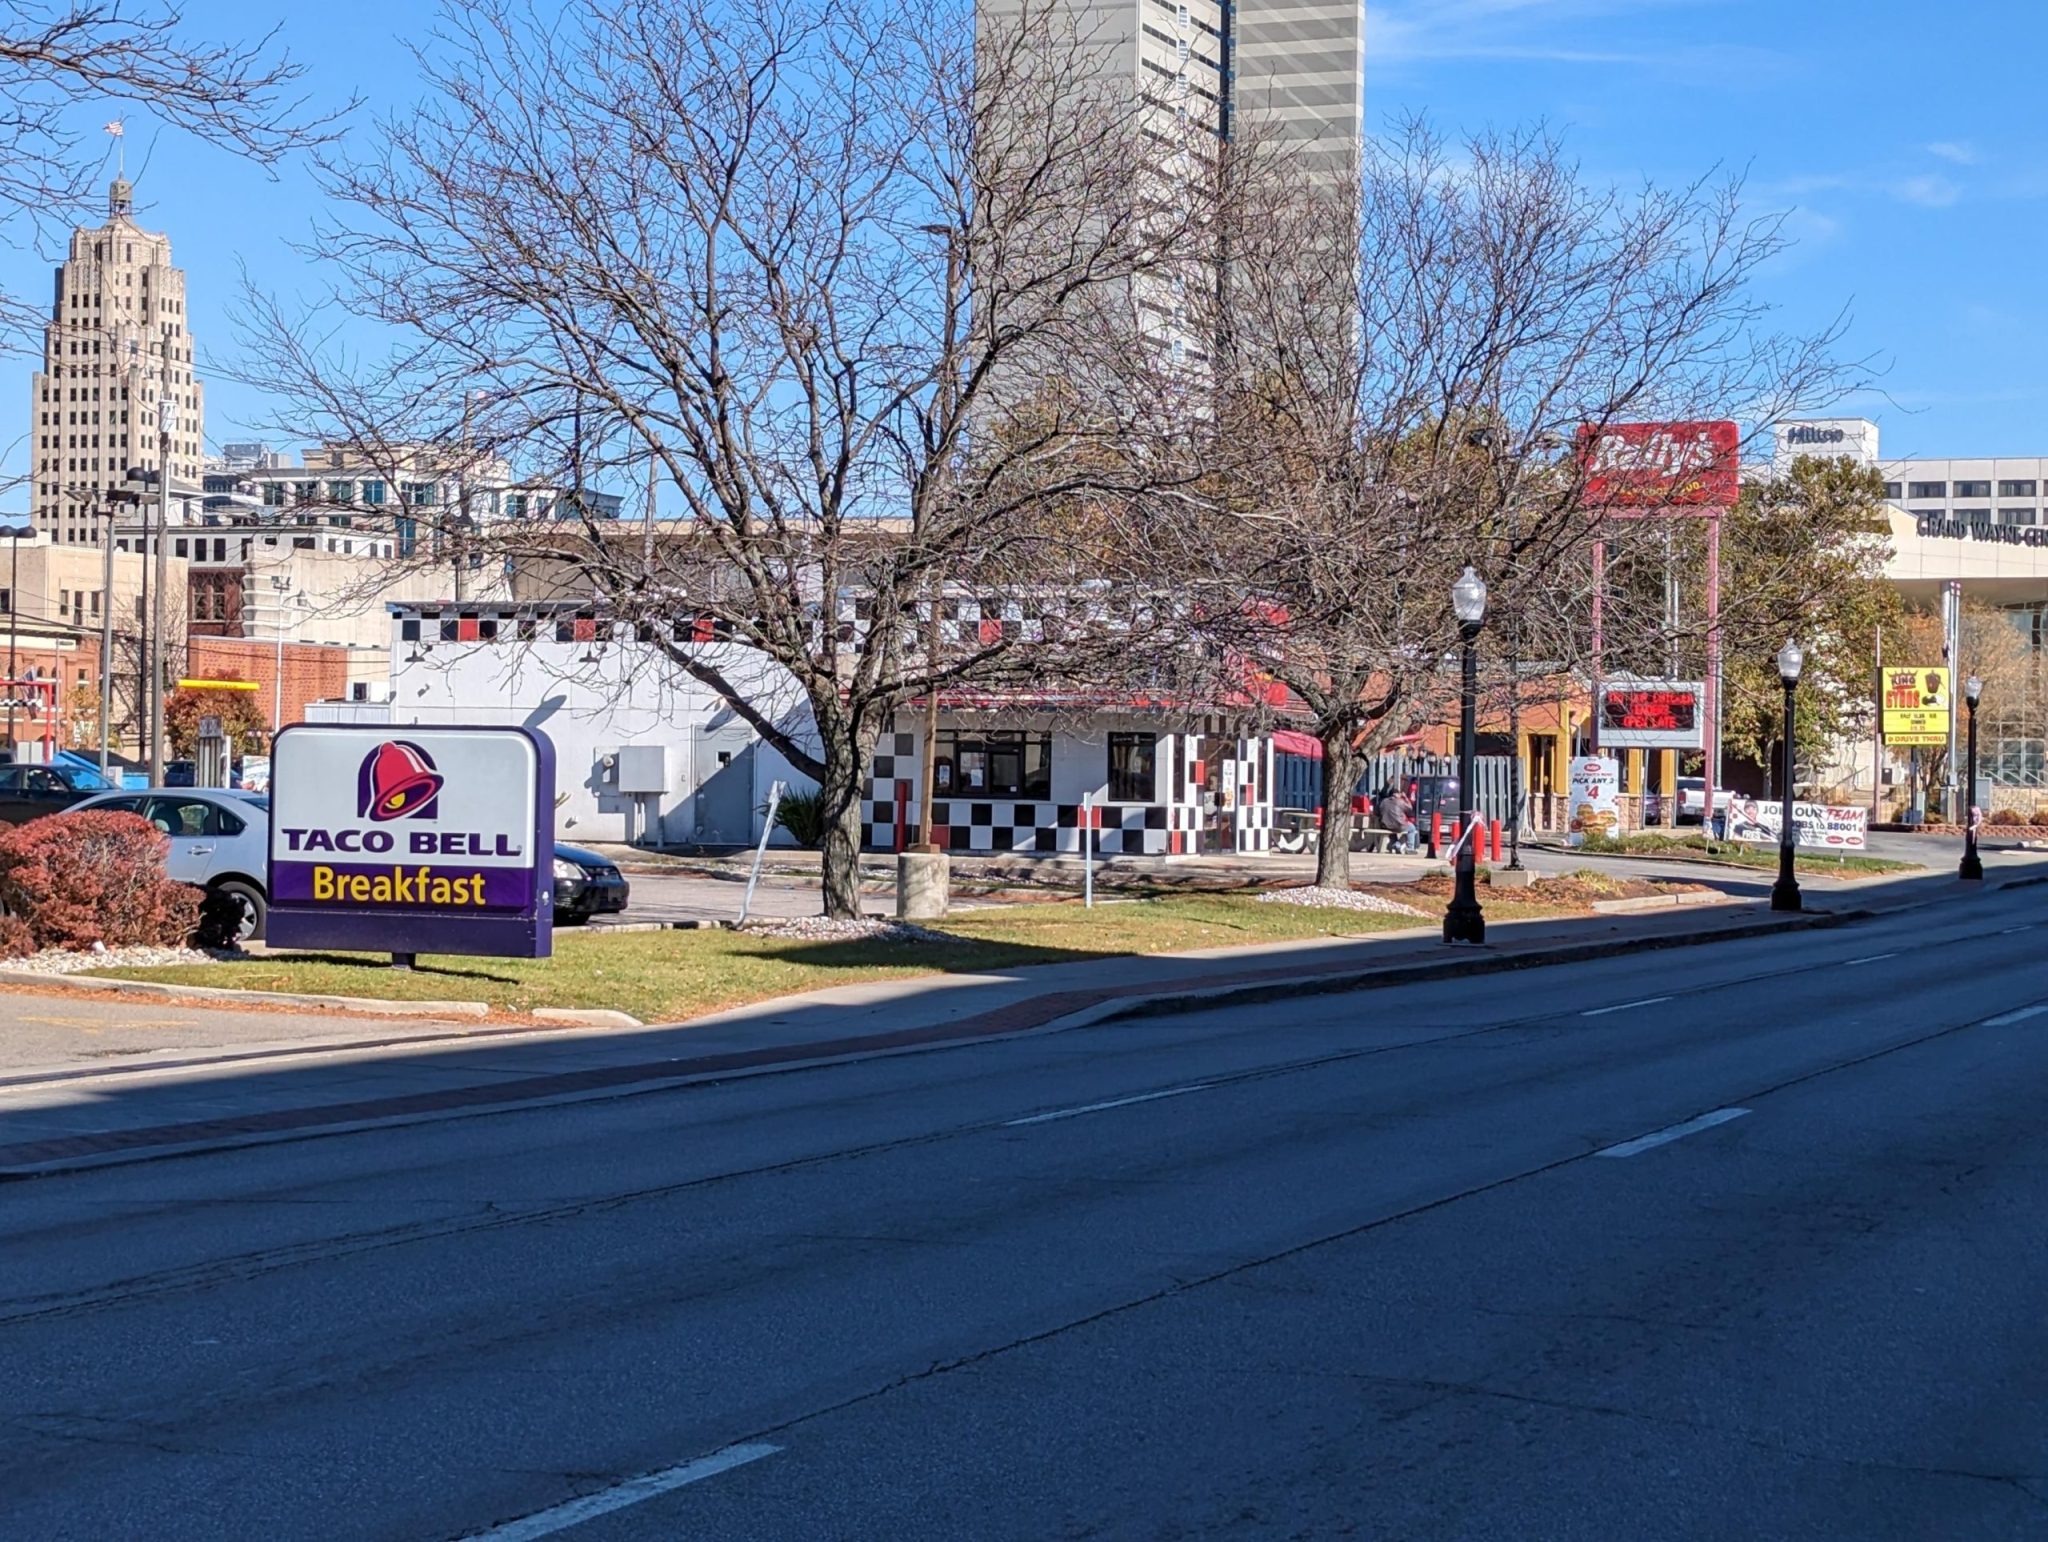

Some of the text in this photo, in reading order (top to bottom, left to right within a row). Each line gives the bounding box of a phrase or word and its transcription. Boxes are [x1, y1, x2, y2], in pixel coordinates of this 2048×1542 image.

[1916, 515, 1968, 540] GRAND
[1970, 519, 2021, 546] WAYNE
[1891, 675, 1916, 686] KING
[1763, 805, 1864, 821] JOI OUR TEAM
[1827, 823, 1857, 832] 88001
[282, 829, 522, 857] TACO BELL
[313, 865, 486, 905] Breakfast
